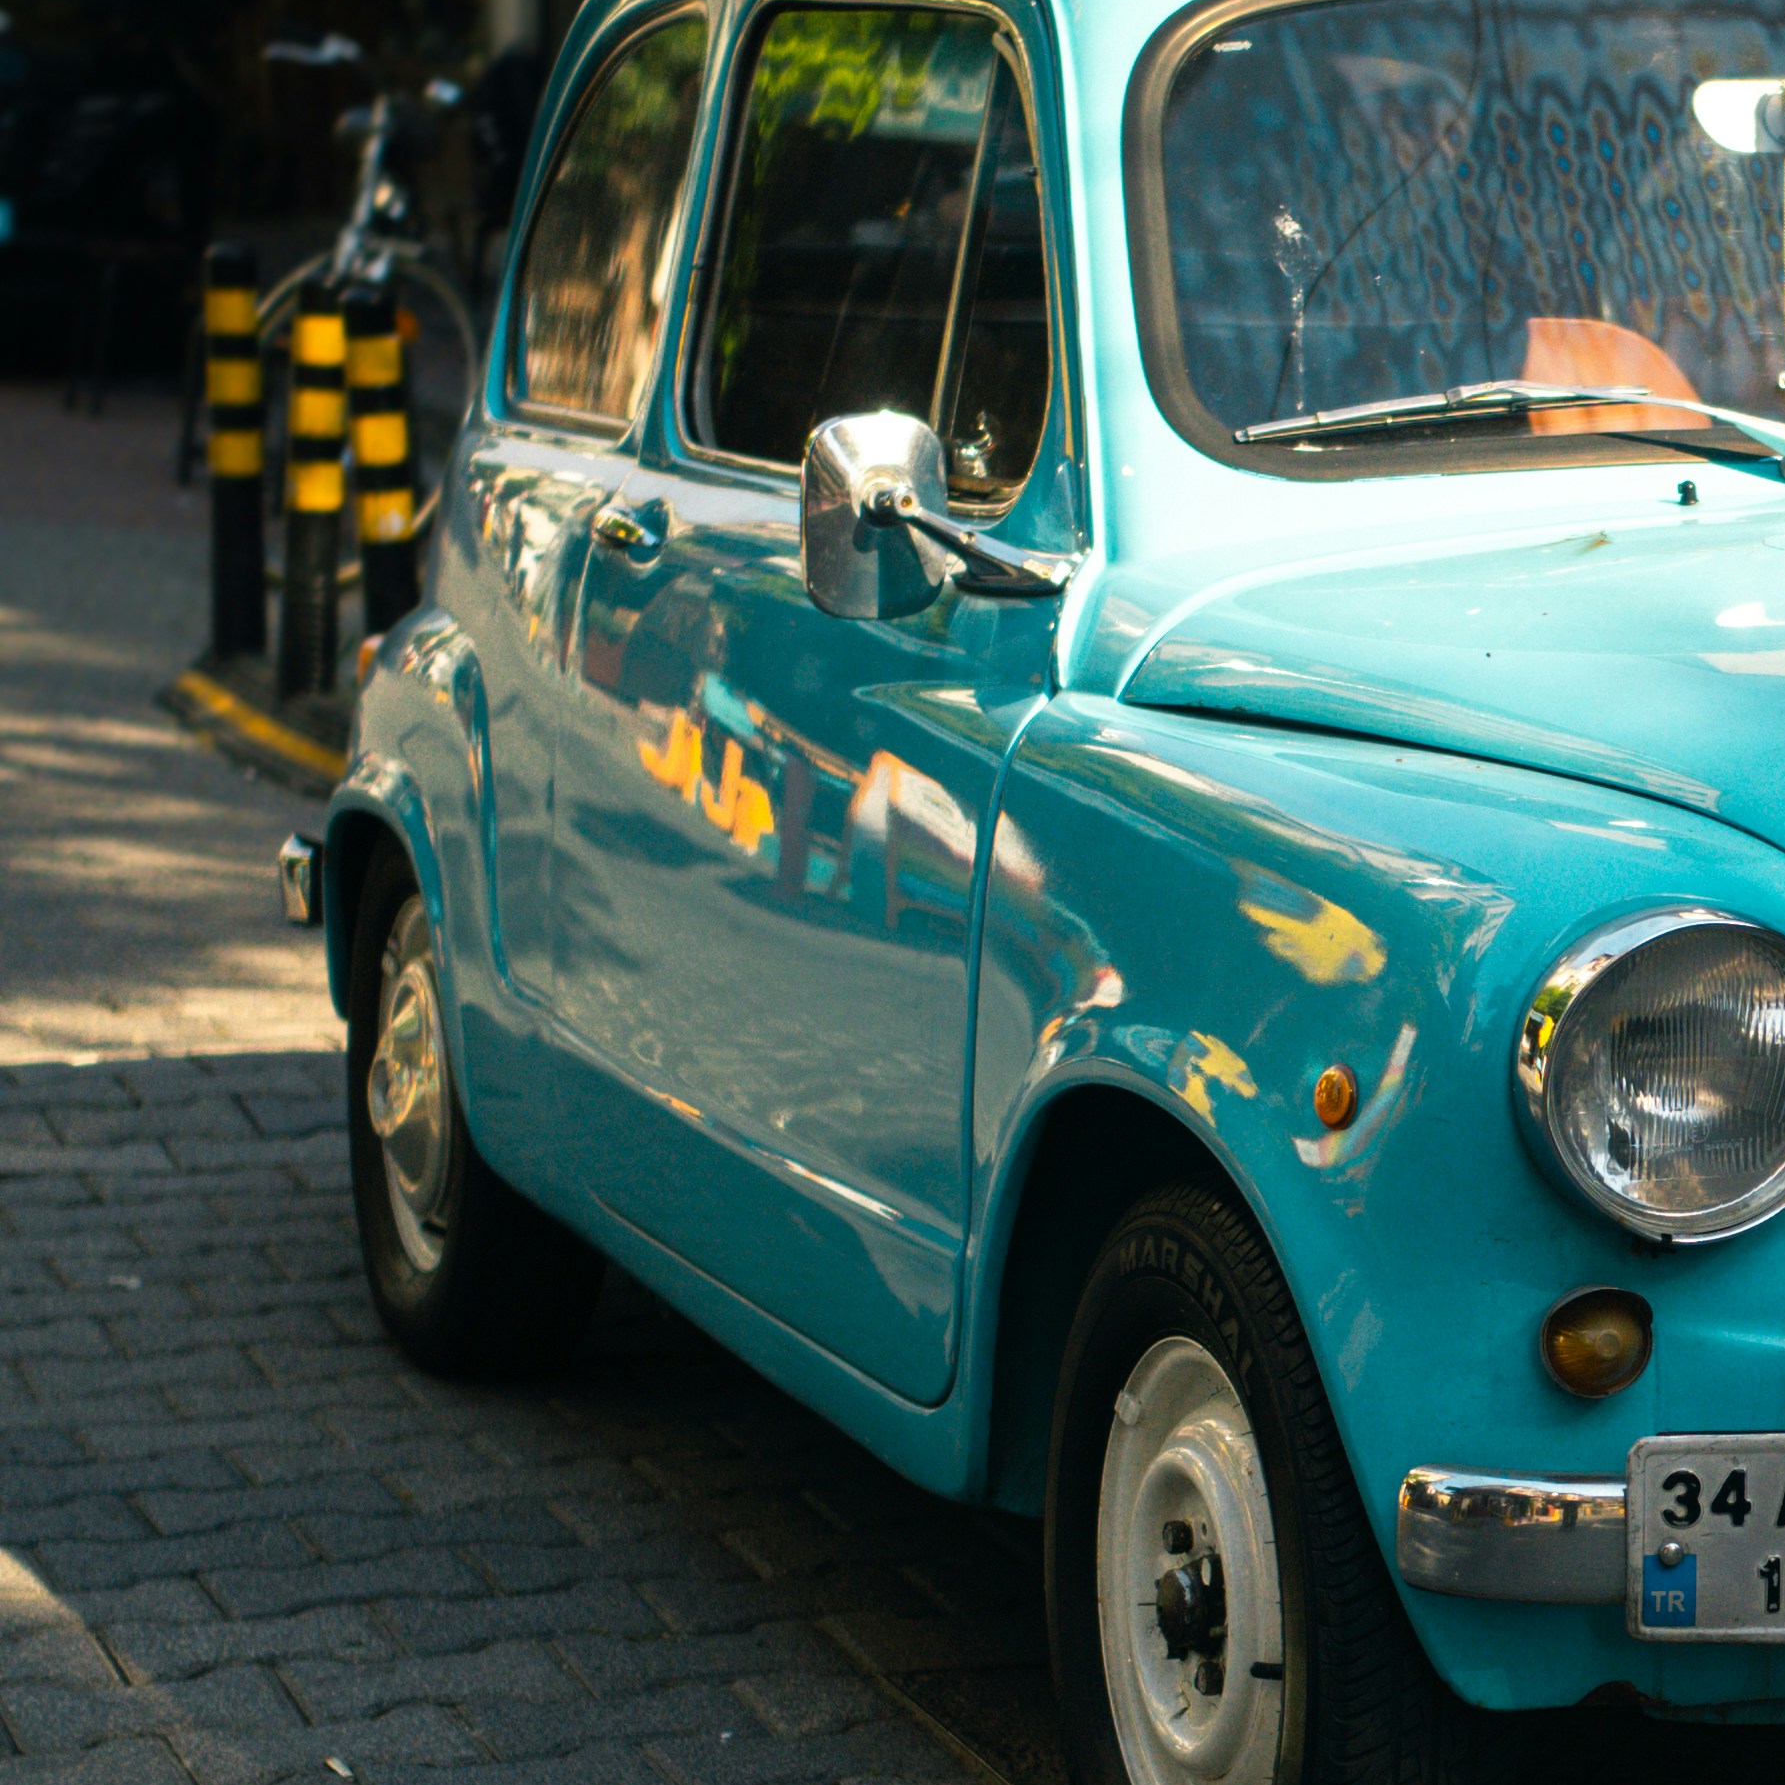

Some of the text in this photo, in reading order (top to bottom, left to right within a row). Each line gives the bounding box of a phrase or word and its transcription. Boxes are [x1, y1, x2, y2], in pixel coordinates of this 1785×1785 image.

[1119, 1234, 1254, 1397] MARSHAL
[1661, 1468, 1752, 1527] 34
[1651, 1590, 1685, 1613] TR
